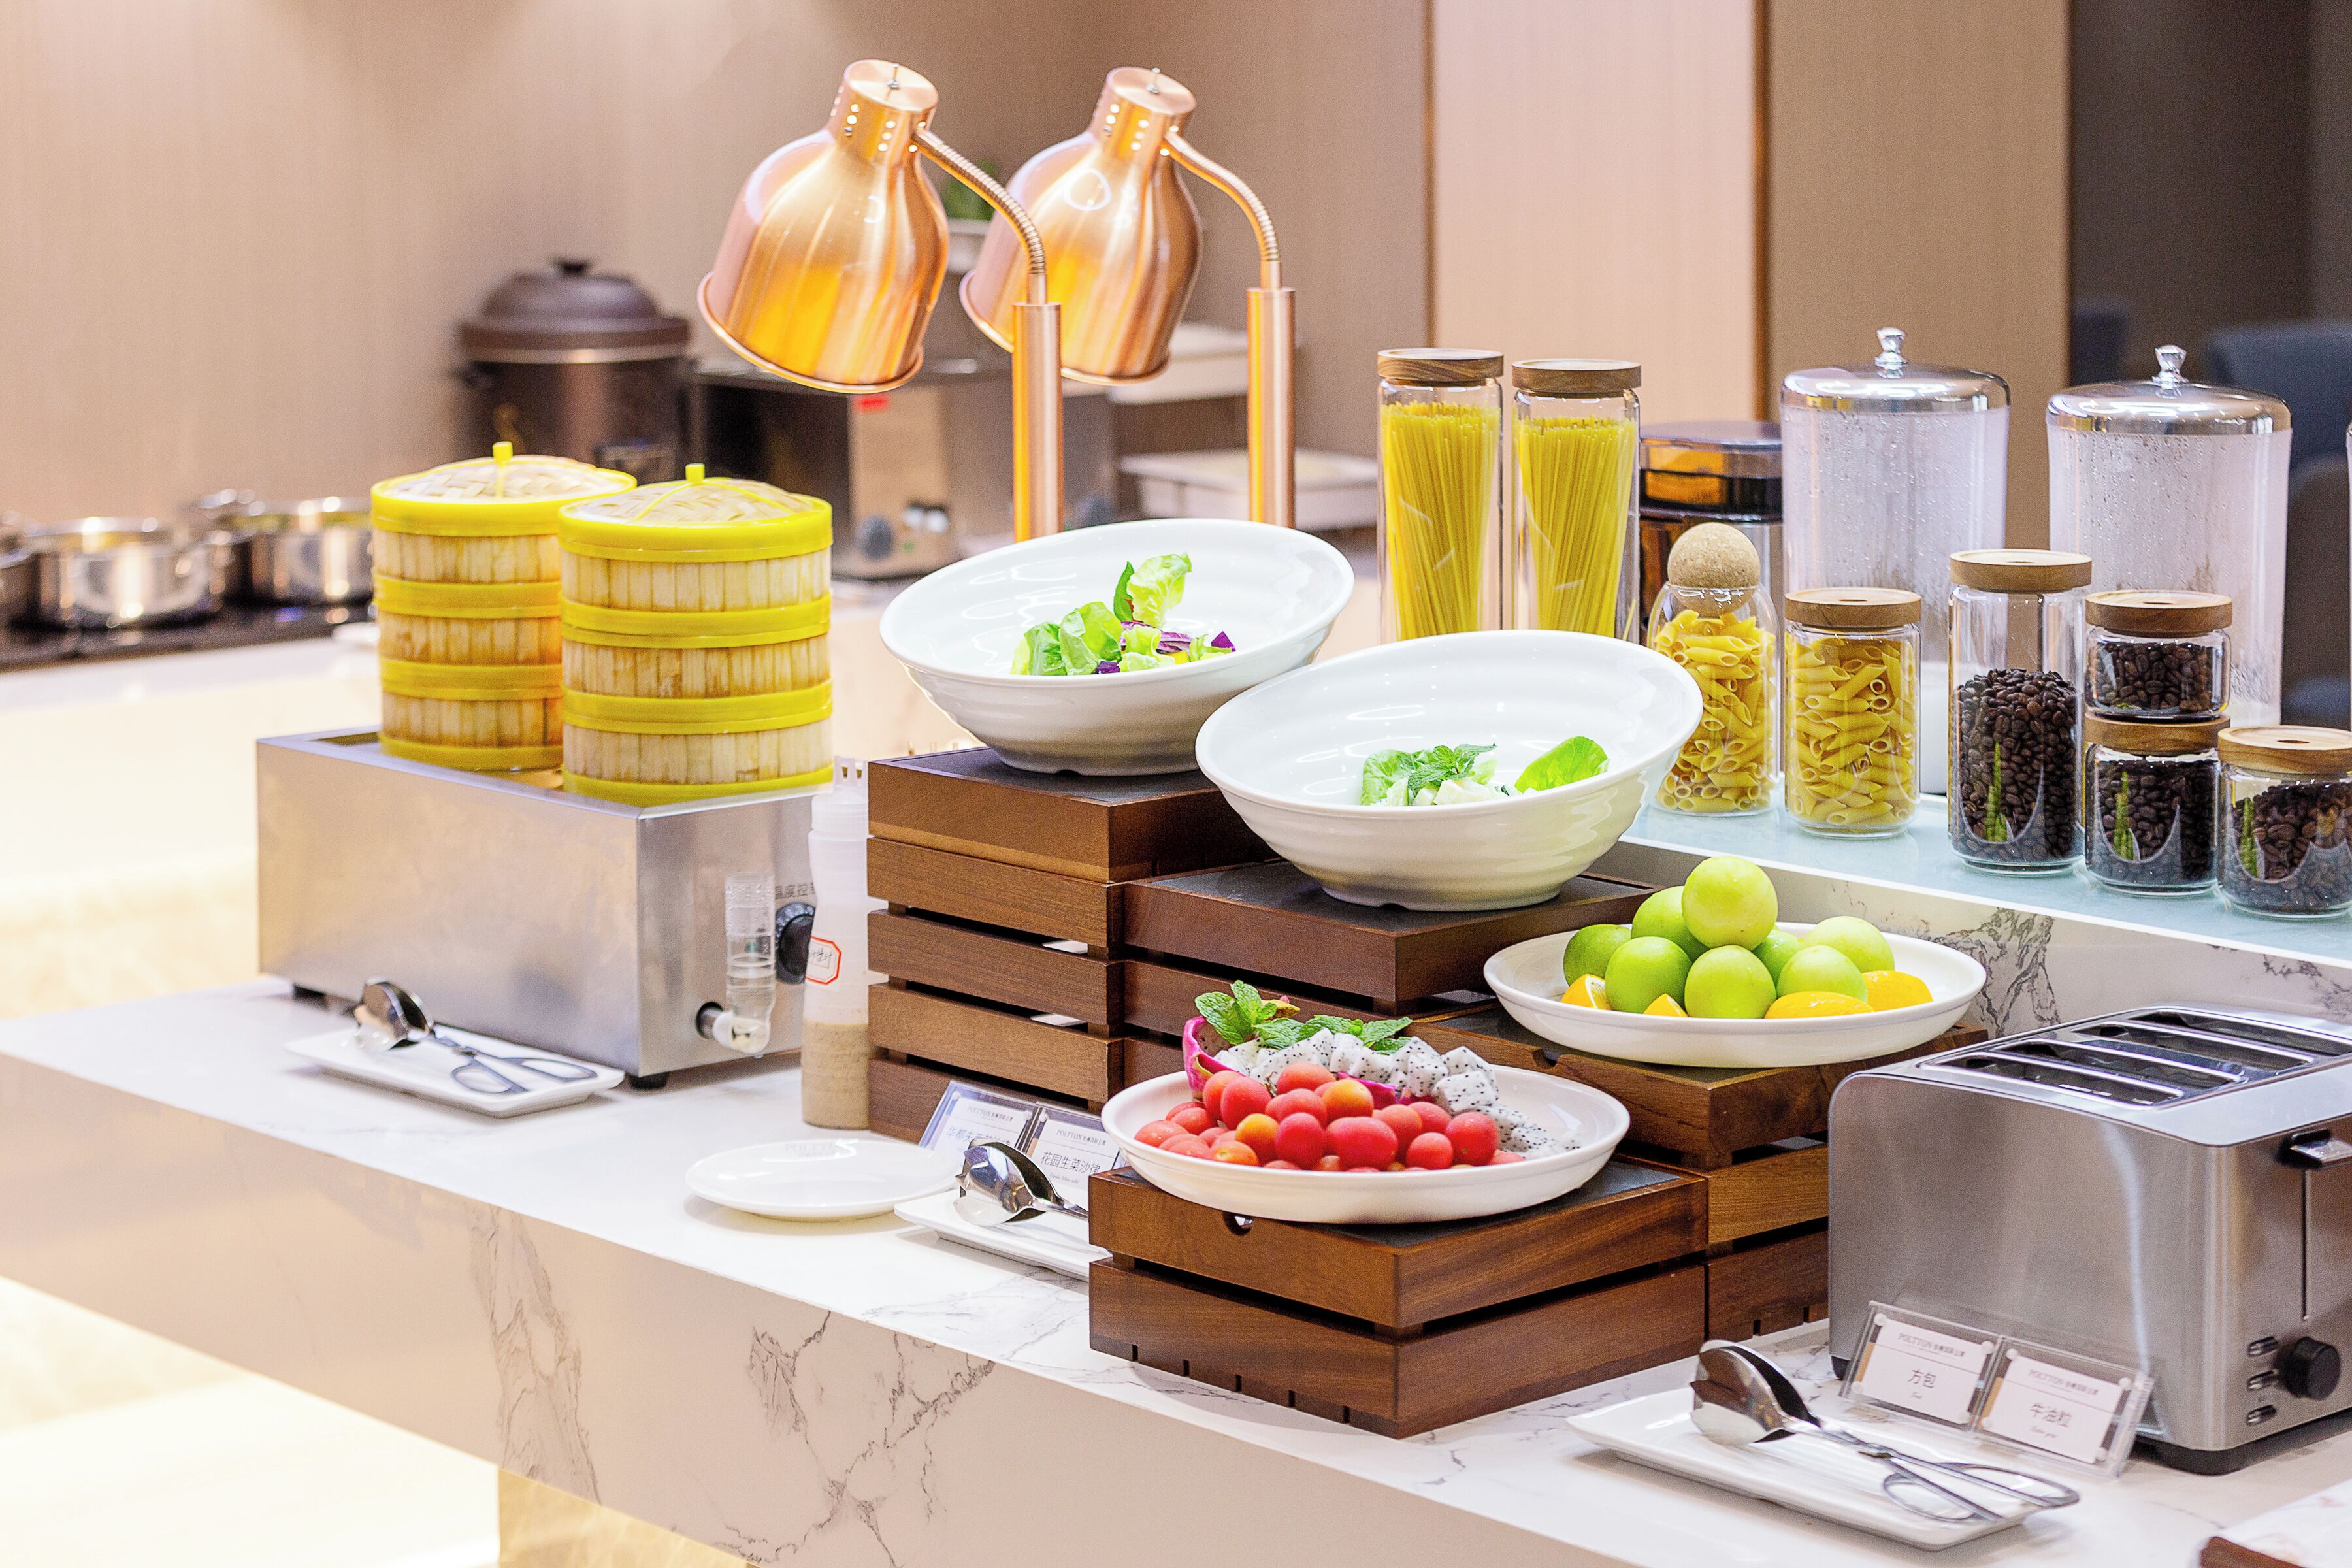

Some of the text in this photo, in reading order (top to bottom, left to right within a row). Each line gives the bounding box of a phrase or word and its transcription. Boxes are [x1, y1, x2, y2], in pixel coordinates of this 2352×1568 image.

[1041, 1151, 1101, 1175] 花园生菜沙律
[1908, 1369, 1937, 1388] 方包
